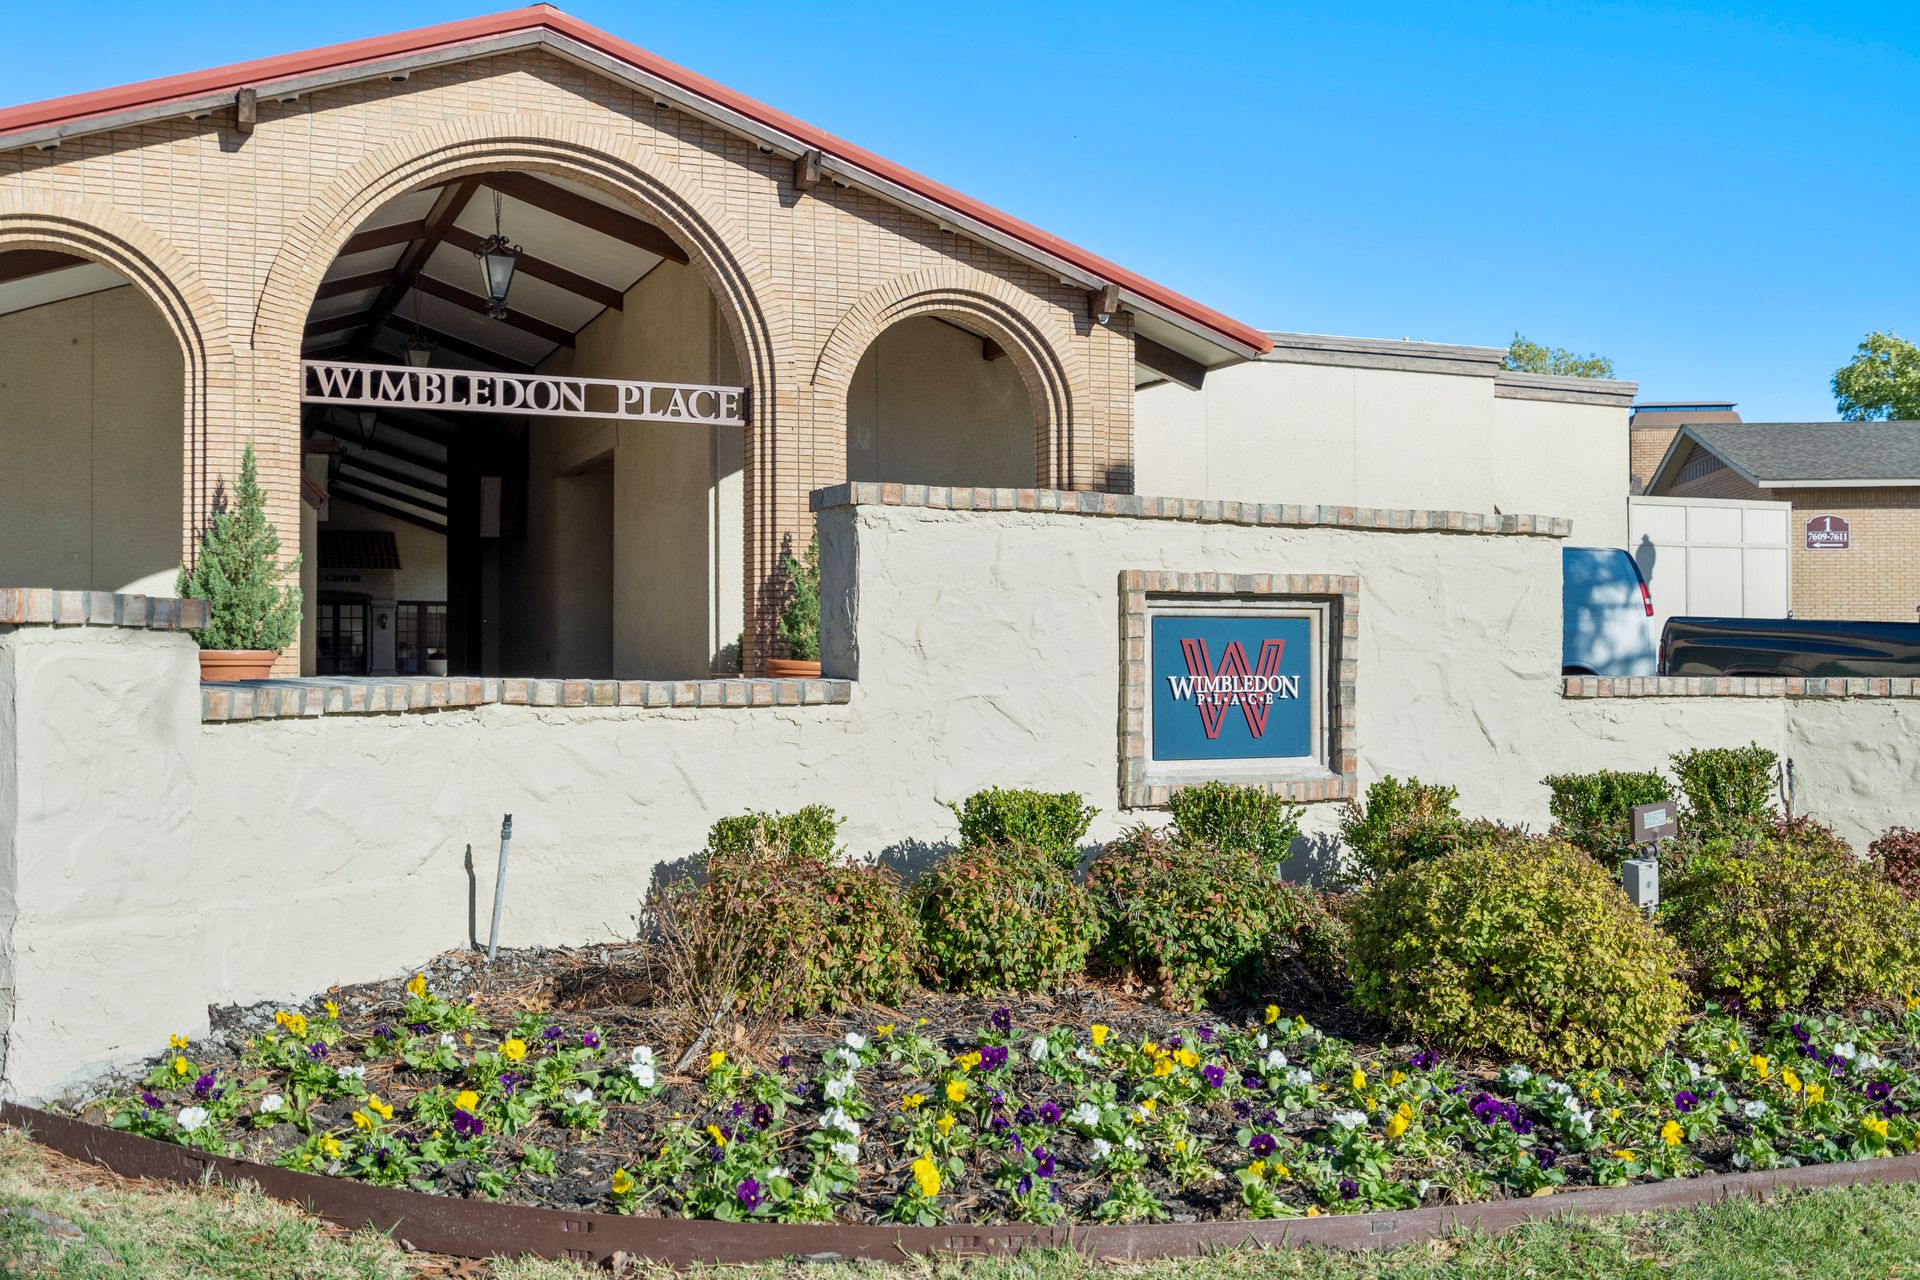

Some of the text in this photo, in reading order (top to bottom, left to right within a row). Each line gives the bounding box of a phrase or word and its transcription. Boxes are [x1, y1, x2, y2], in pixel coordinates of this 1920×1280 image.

[312, 366, 739, 421] WIMBLEDON PLACE
[1807, 532, 1848, 541] 7609-7611
[1823, 517, 1831, 531] 1
[1168, 675, 1300, 700] WIMBLEDON
[1179, 638, 1286, 739] W
